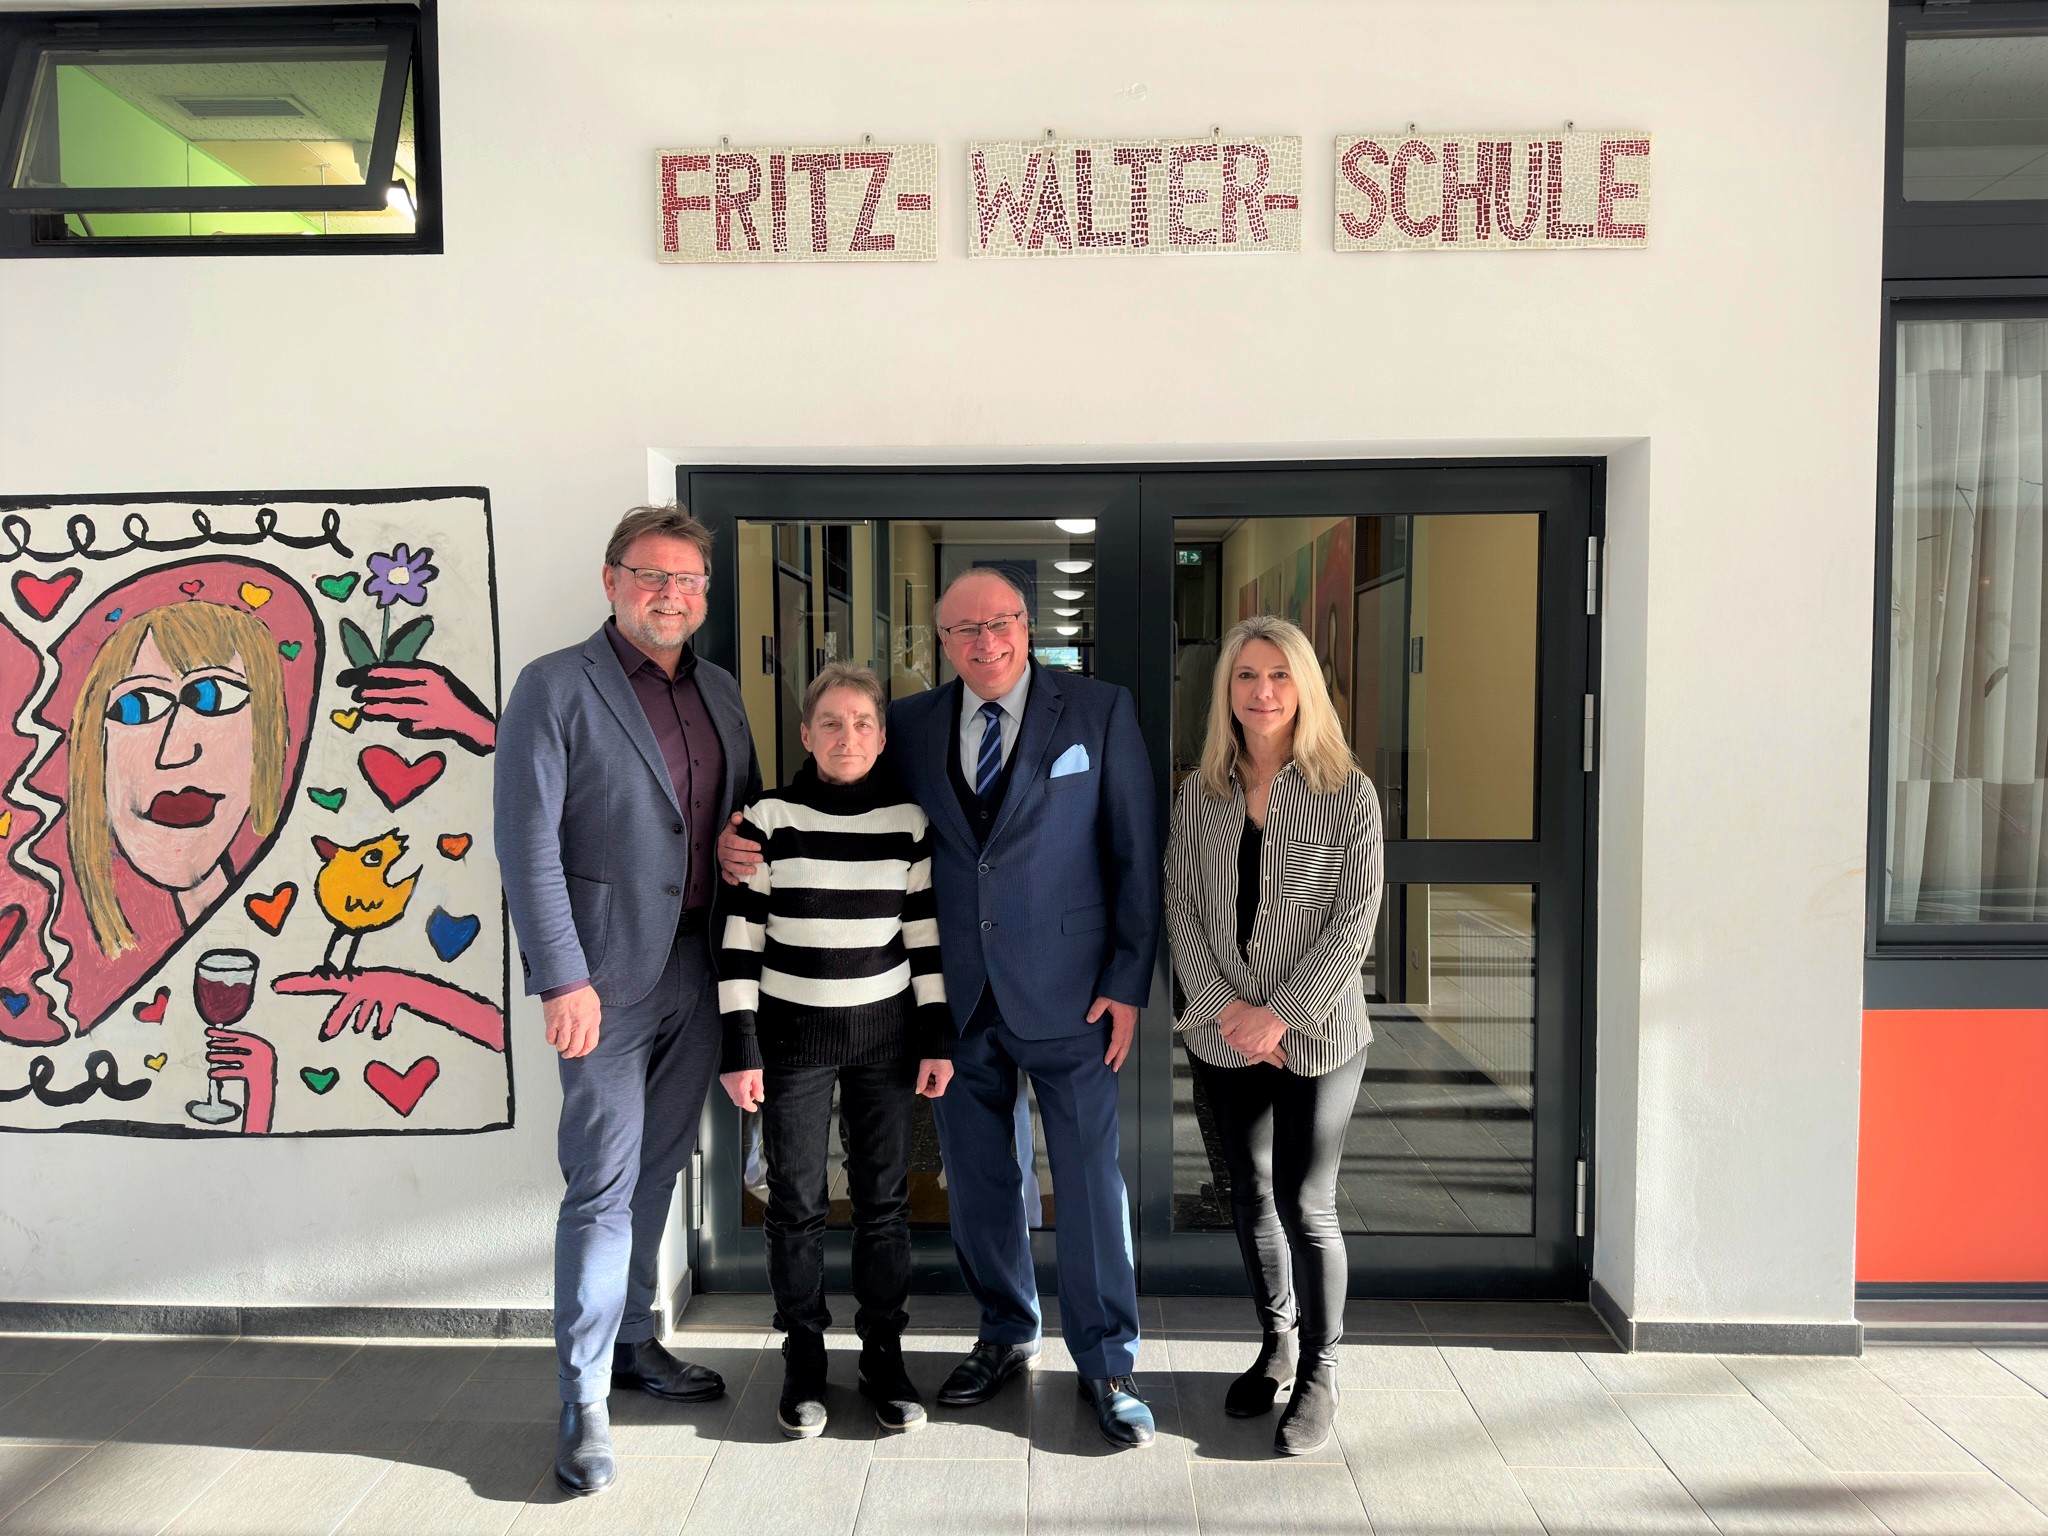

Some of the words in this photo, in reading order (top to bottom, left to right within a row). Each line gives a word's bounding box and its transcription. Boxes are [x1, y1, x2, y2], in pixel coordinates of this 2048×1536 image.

[661, 152, 931, 253] FRITZ-
[971, 144, 1299, 250] WALTER-
[1339, 139, 1651, 242] SCHULE
